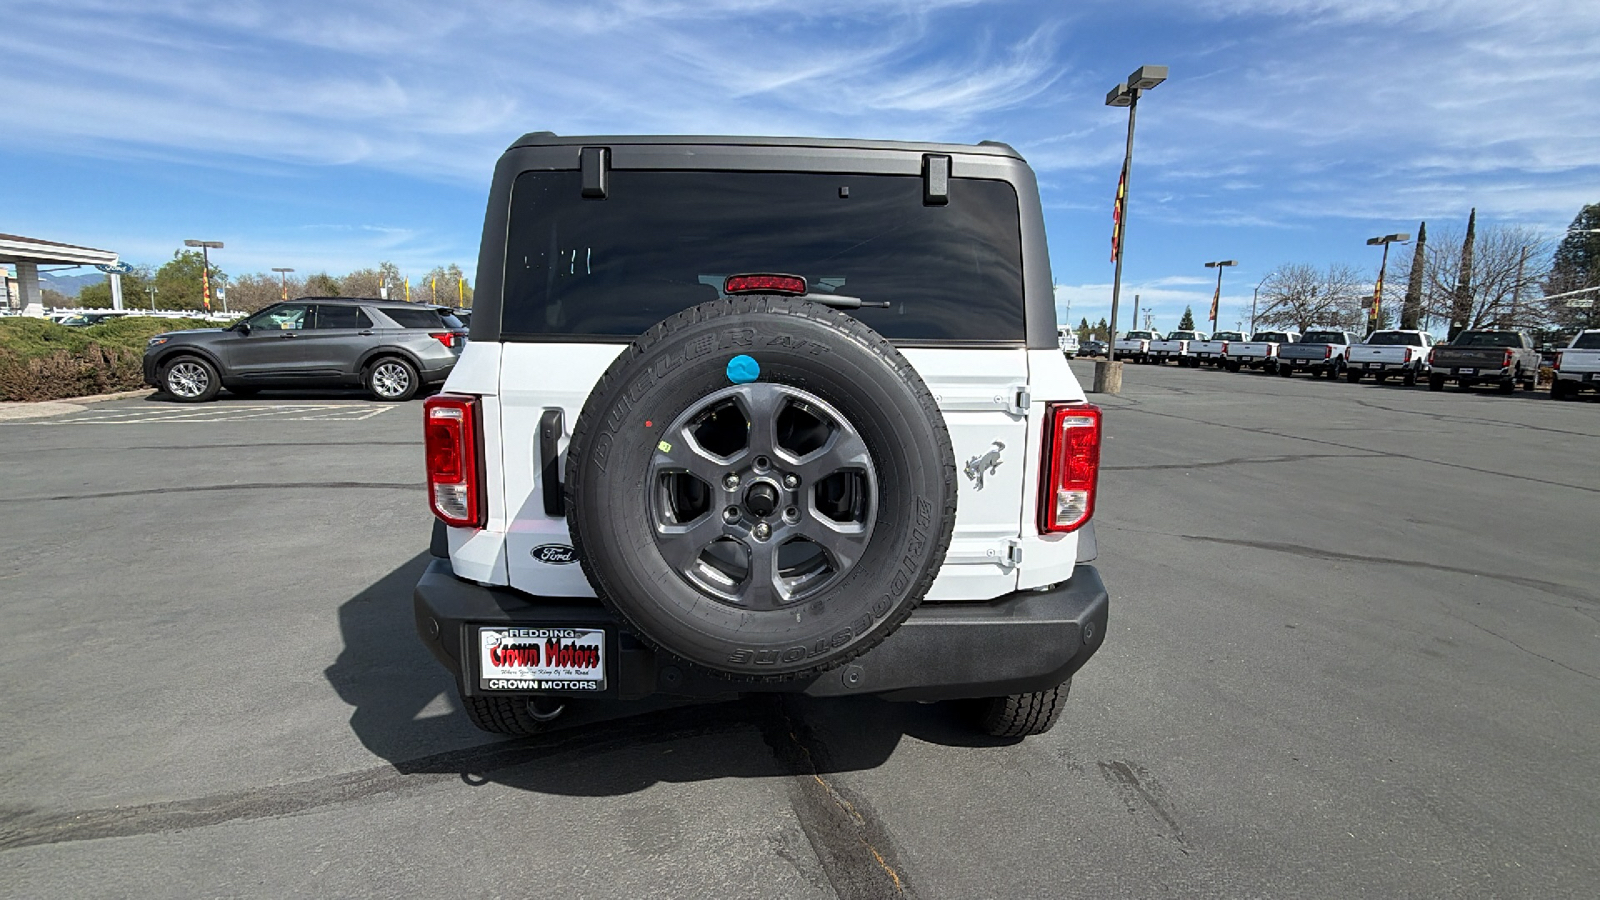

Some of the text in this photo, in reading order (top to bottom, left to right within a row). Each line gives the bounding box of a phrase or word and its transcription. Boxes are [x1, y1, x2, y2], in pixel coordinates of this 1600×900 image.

[541, 547, 573, 561] Ford
[728, 495, 932, 666] BRIDGESTONE
[509, 629, 575, 638] REDDING
[490, 638, 599, 668] Crown Motors
[489, 680, 597, 689] CROWN MOTORS
